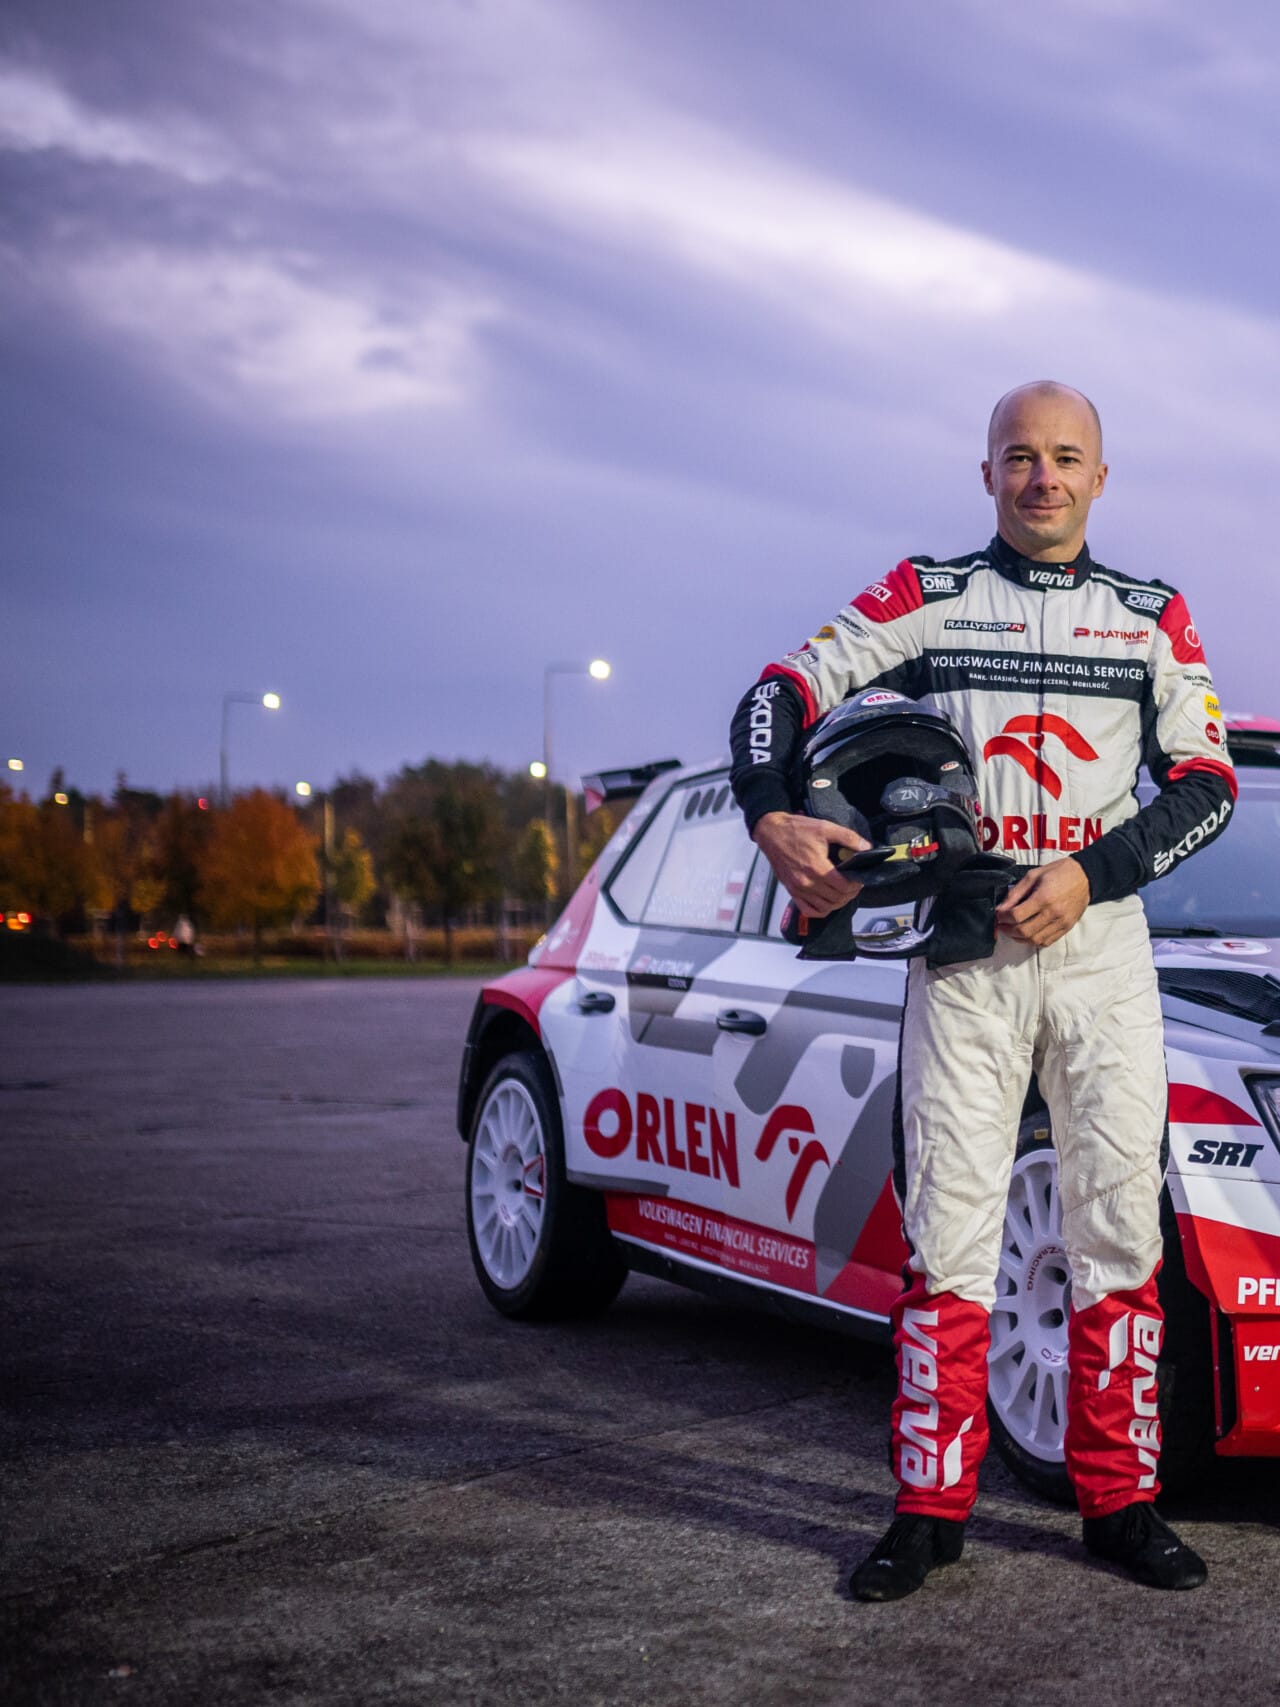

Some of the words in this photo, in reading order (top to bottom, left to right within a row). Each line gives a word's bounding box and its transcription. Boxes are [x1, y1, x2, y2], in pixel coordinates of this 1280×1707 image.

[922, 577, 956, 590] OMP
[1028, 570, 1076, 588] verva
[1127, 593, 1164, 610] OMP
[1093, 630, 1149, 641] PLATINUM
[930, 656, 1019, 670] VOLKSWAGEN
[1022, 662, 1090, 677] FINANCIAL
[1094, 667, 1145, 681] SERVICES
[1153, 799, 1233, 878] ŠKODA
[583, 1087, 741, 1189] ORLEN
[1187, 1139, 1264, 1168] SRT
[638, 1198, 703, 1234] VOLKSWAGEN
[704, 1219, 756, 1255] FINANCIAL
[757, 1236, 809, 1269] SERVICES
[901, 1307, 939, 1489] verva
[1127, 1314, 1164, 1488] verva
